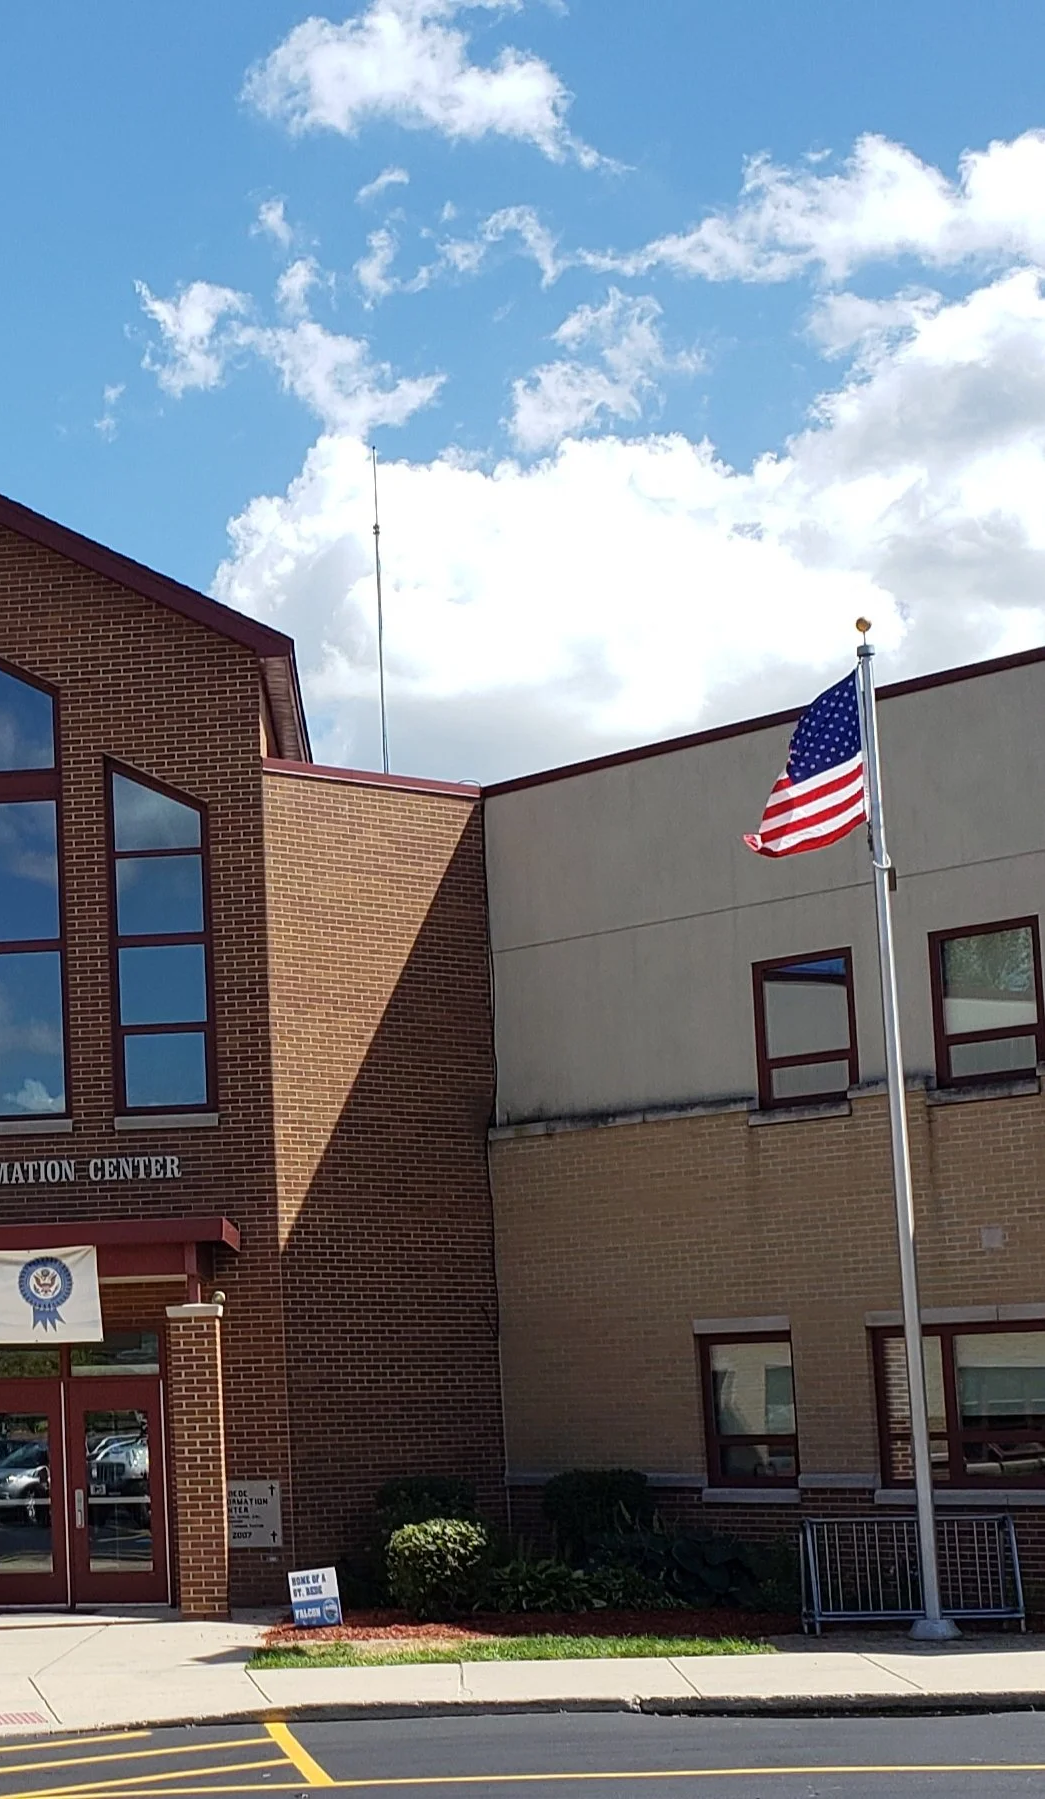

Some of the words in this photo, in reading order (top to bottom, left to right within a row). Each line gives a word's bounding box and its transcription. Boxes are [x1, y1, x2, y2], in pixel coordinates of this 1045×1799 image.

[89, 1156, 182, 1181] CENTER
[232, 1531, 252, 1540] 2007
[291, 1575, 311, 1587] HOME
[311, 1573, 320, 1584] OF
[321, 1573, 327, 1583] A
[305, 1584, 324, 1597] BEDE
